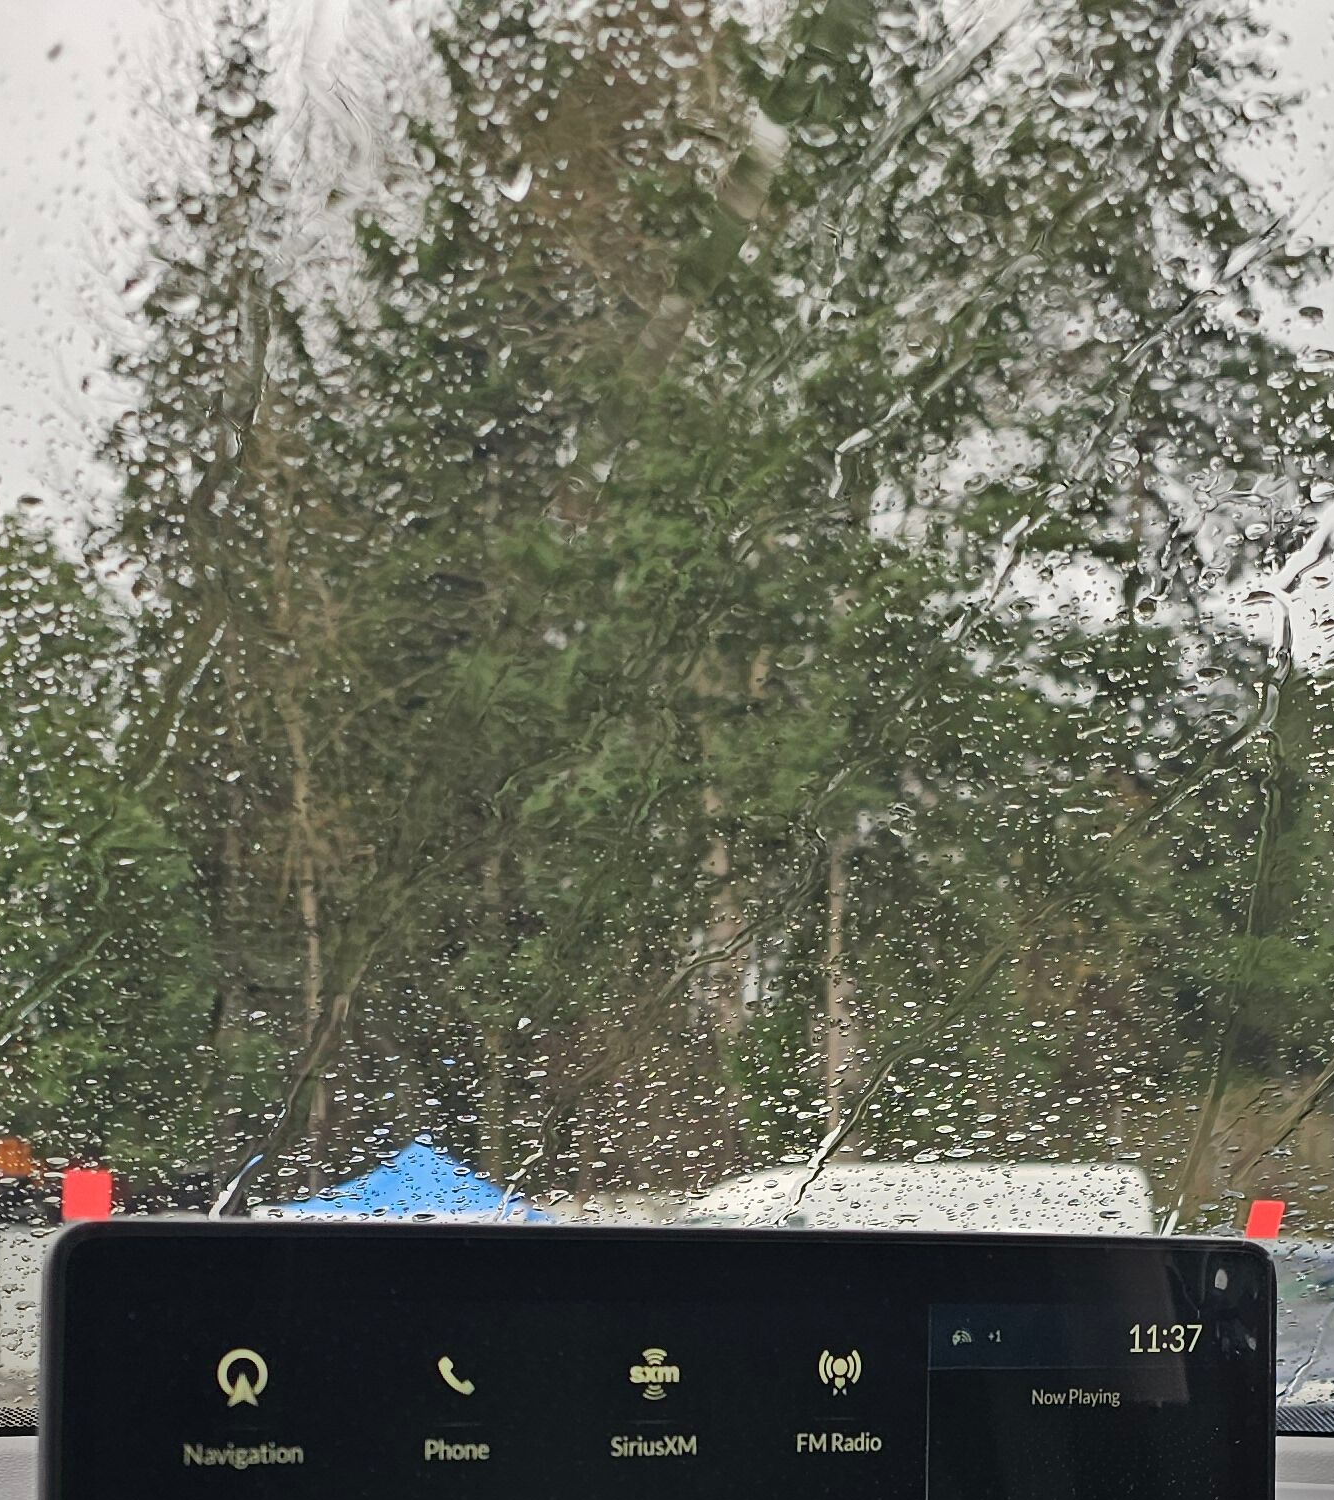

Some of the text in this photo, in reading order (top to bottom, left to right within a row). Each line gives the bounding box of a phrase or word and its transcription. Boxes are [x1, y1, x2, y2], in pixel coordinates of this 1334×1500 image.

[1128, 1323, 1203, 1355] 11:37
[629, 1362, 680, 1385] sxm
[1031, 1387, 1121, 1408] Now Playing
[424, 1439, 490, 1462] Phone
[610, 1435, 698, 1458] SiriusXM
[796, 1432, 883, 1453] FM Radio
[183, 1442, 304, 1469] Navigation
